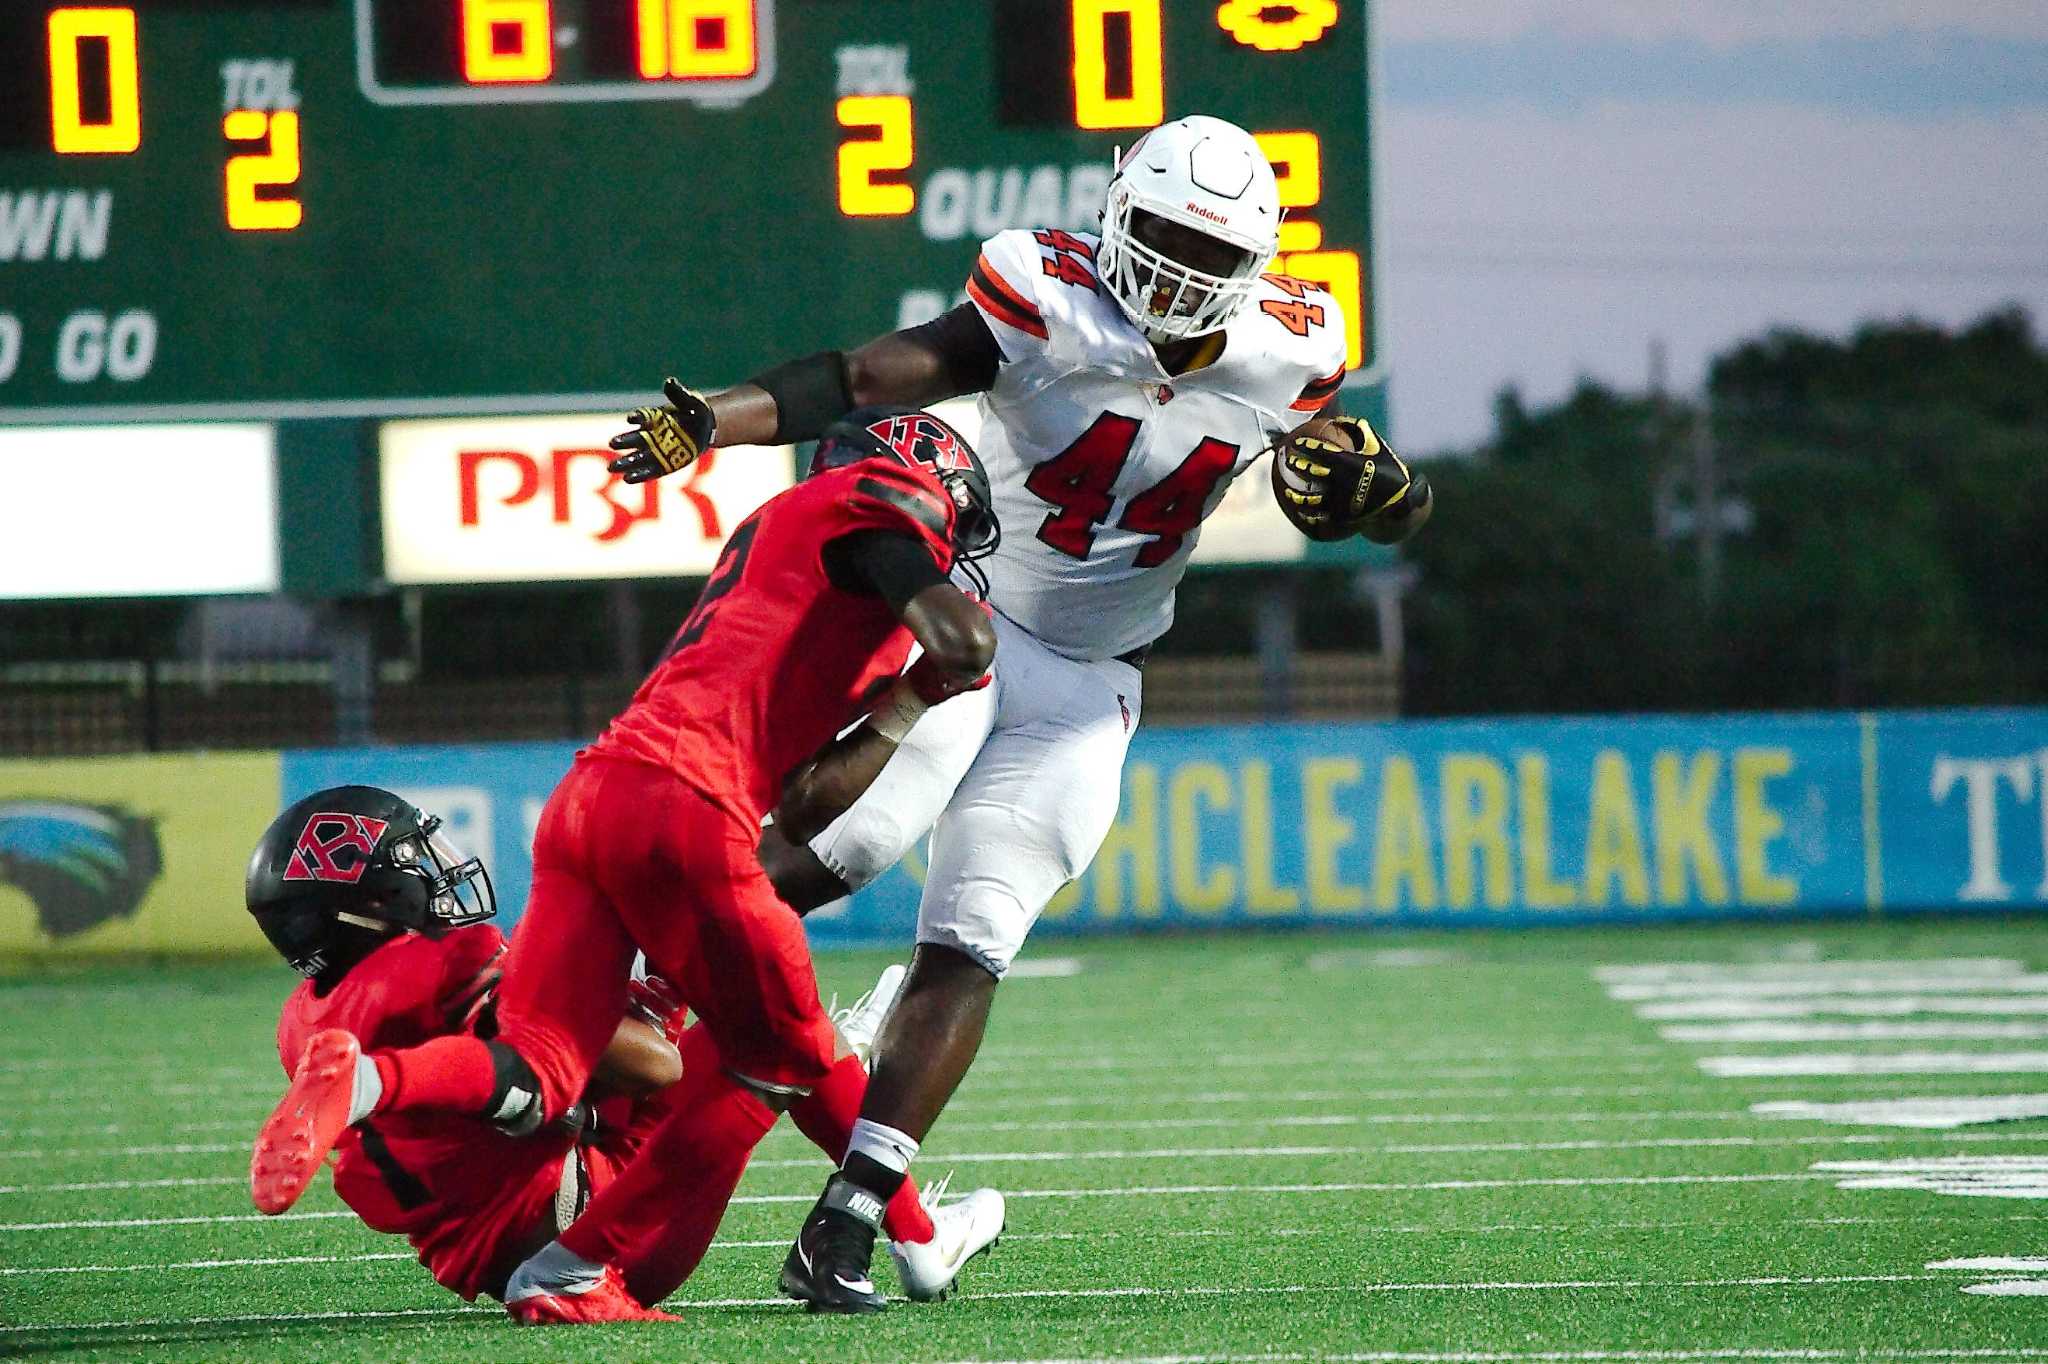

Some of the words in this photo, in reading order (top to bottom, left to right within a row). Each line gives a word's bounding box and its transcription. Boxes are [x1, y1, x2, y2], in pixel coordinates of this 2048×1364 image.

[48, 7, 140, 153] 0
[1071, 0, 1163, 130] 0
[222, 108, 303, 232] 2
[835, 95, 915, 216] 2
[1186, 202, 1229, 225] Riddell
[57, 308, 158, 384] GO
[1024, 409, 1241, 569] 44
[1046, 748, 1798, 912] HCLEARLAKE
